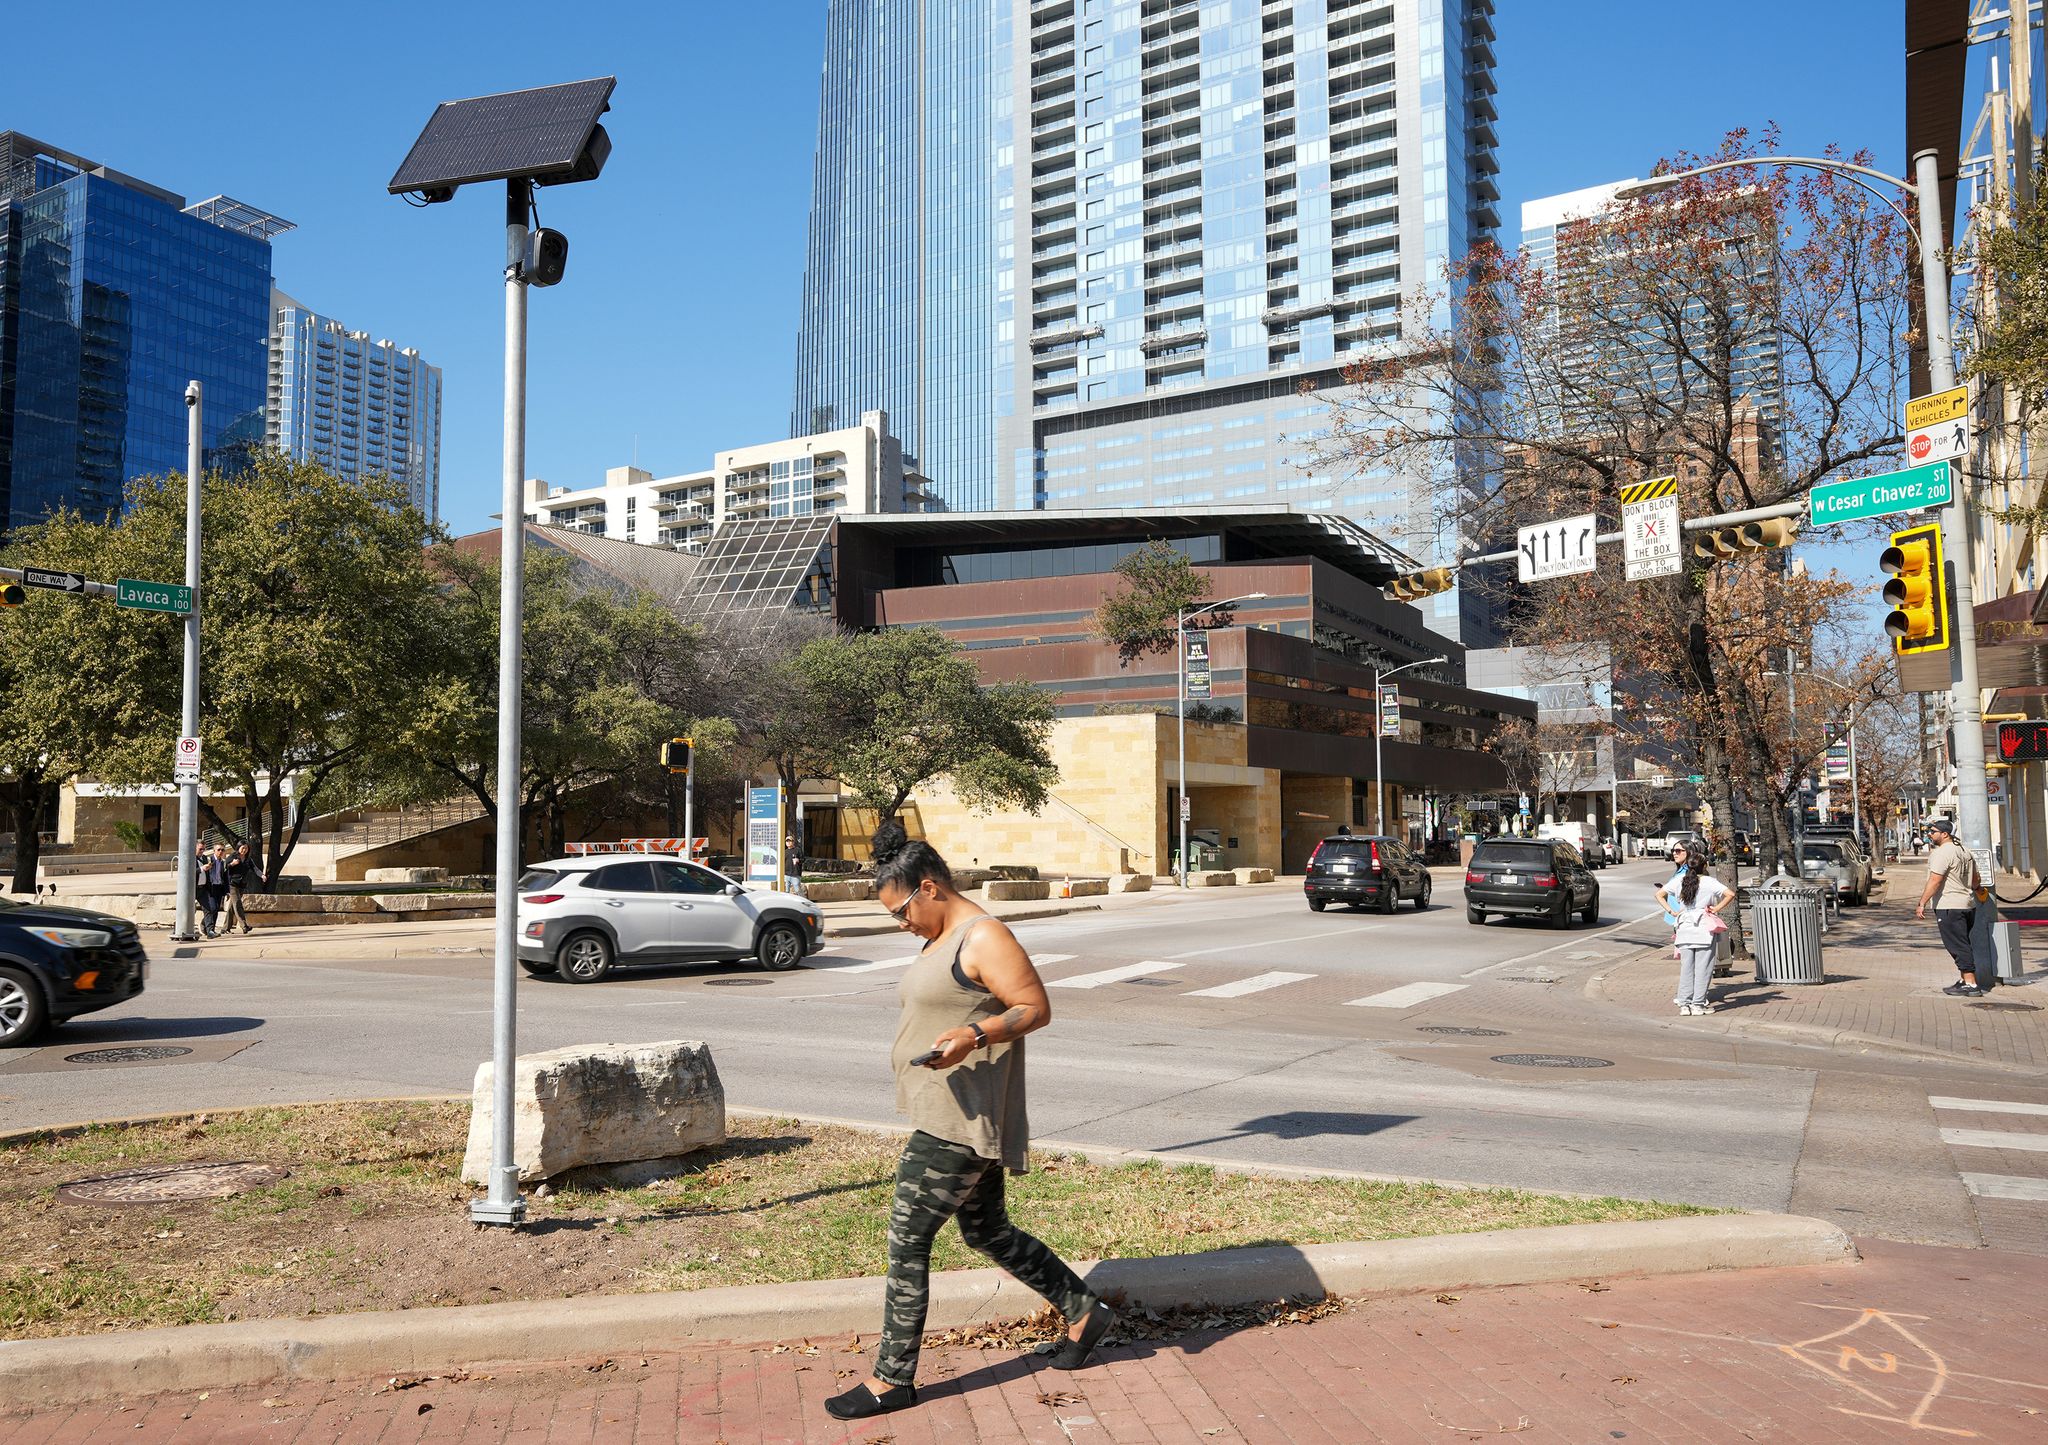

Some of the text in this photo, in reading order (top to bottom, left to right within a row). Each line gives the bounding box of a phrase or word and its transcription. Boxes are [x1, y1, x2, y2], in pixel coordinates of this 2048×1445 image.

[1911, 396, 1948, 413] TURNING
[1910, 409, 1950, 426] VEHICLES
[1910, 436, 1948, 453] STOP FOR
[1828, 493, 1866, 512] Cesar
[1872, 483, 1923, 504] Chavez
[1933, 468, 1945, 482] ST
[1927, 485, 1946, 499] 200
[1649, 498, 1674, 511] BLOCK
[1635, 544, 1671, 558] THE BOX
[1539, 557, 1593, 574] ONLY ONLY ONLY
[1633, 565, 1674, 577] $500 FINE
[1641, 559, 1665, 569] UP TO
[29, 573, 67, 585] ONE WAY
[119, 585, 189, 605] Lavaca ST
[174, 600, 189, 610] 100
